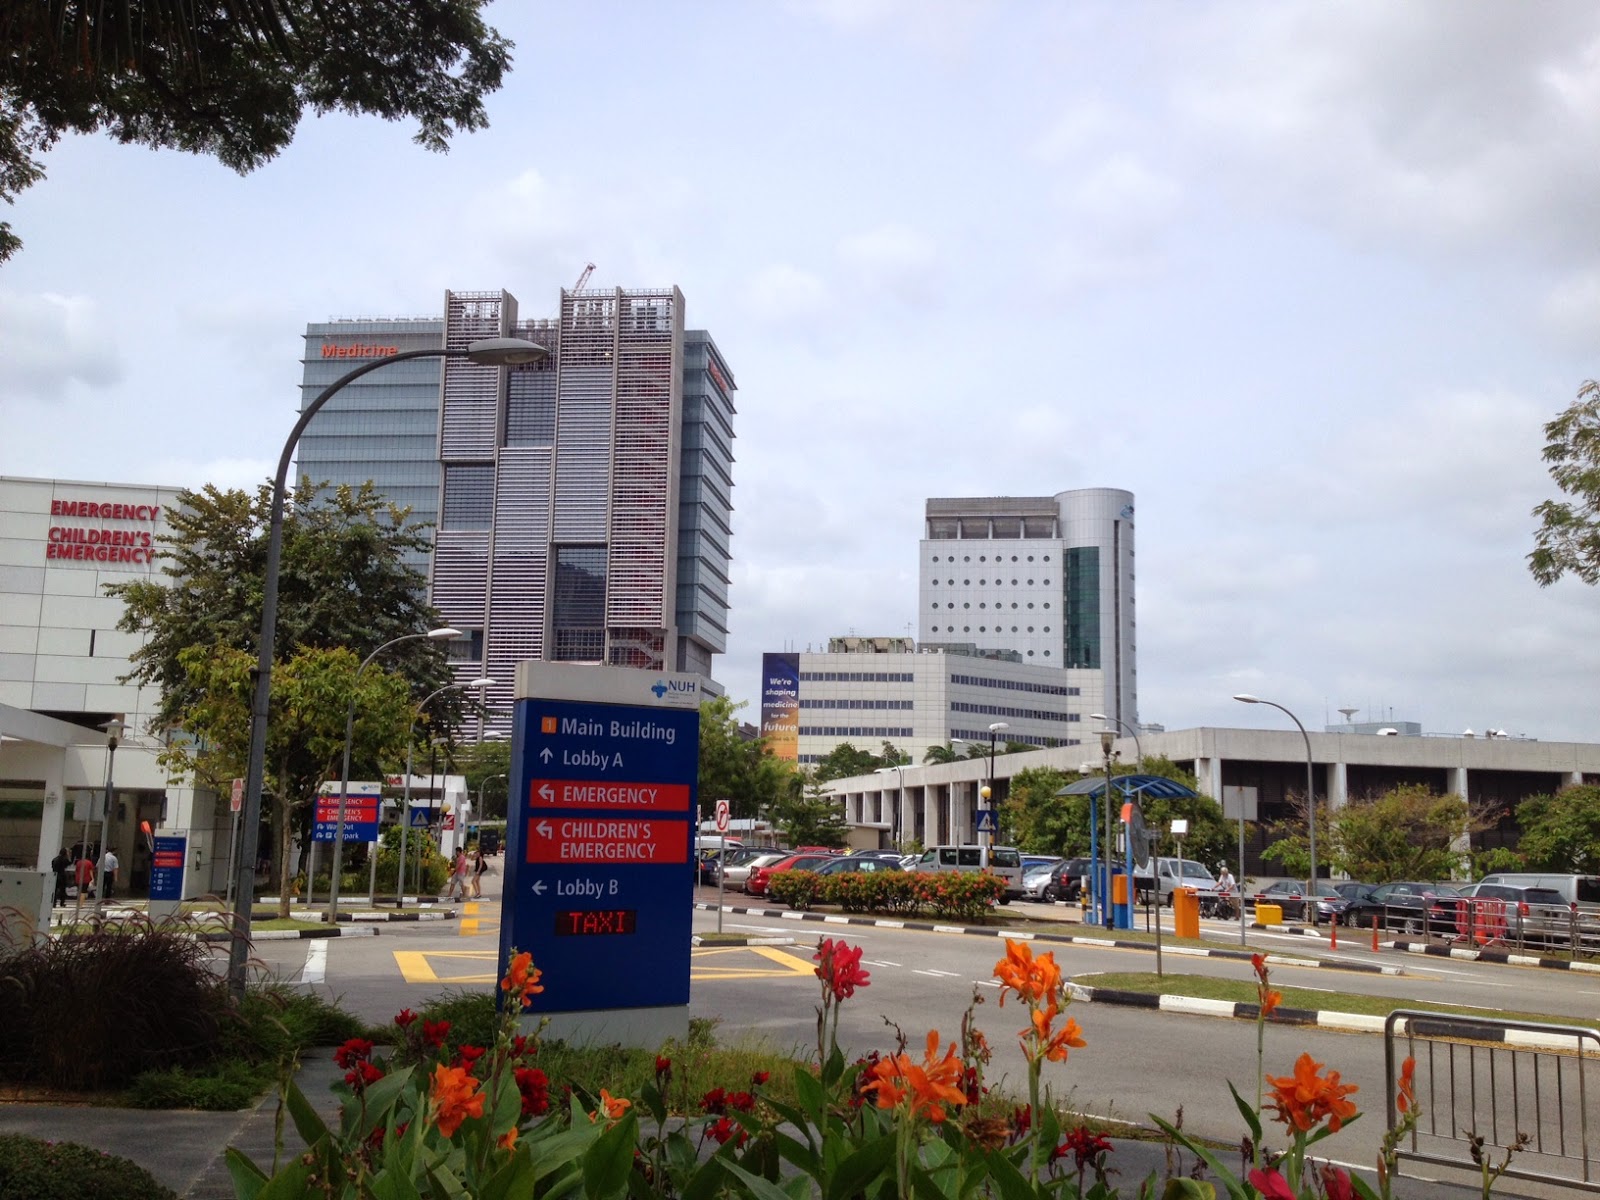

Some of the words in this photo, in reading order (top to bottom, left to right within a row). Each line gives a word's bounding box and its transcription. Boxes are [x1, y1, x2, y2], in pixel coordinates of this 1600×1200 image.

[321, 342, 397, 358] Medicine
[50, 499, 159, 520] EMERGENCY
[48, 526, 151, 547] CHILDREN'S
[46, 543, 156, 563] EMERGENCY
[668, 680, 695, 692] NUH
[769, 677, 792, 685] We're
[765, 688, 796, 697] shaping
[562, 717, 603, 736] Main
[610, 720, 676, 745] Building
[764, 721, 797, 732] future
[563, 749, 609, 771] Lobby
[612, 752, 624, 768] A
[563, 785, 657, 804] EMERGENCY
[333, 832, 359, 840] Crpark
[561, 822, 651, 839] CHILDREN'S
[560, 842, 656, 859] EMERGENCY
[557, 878, 604, 900] Lobby
[609, 879, 619, 895] B
[569, 911, 625, 933] TAXI
